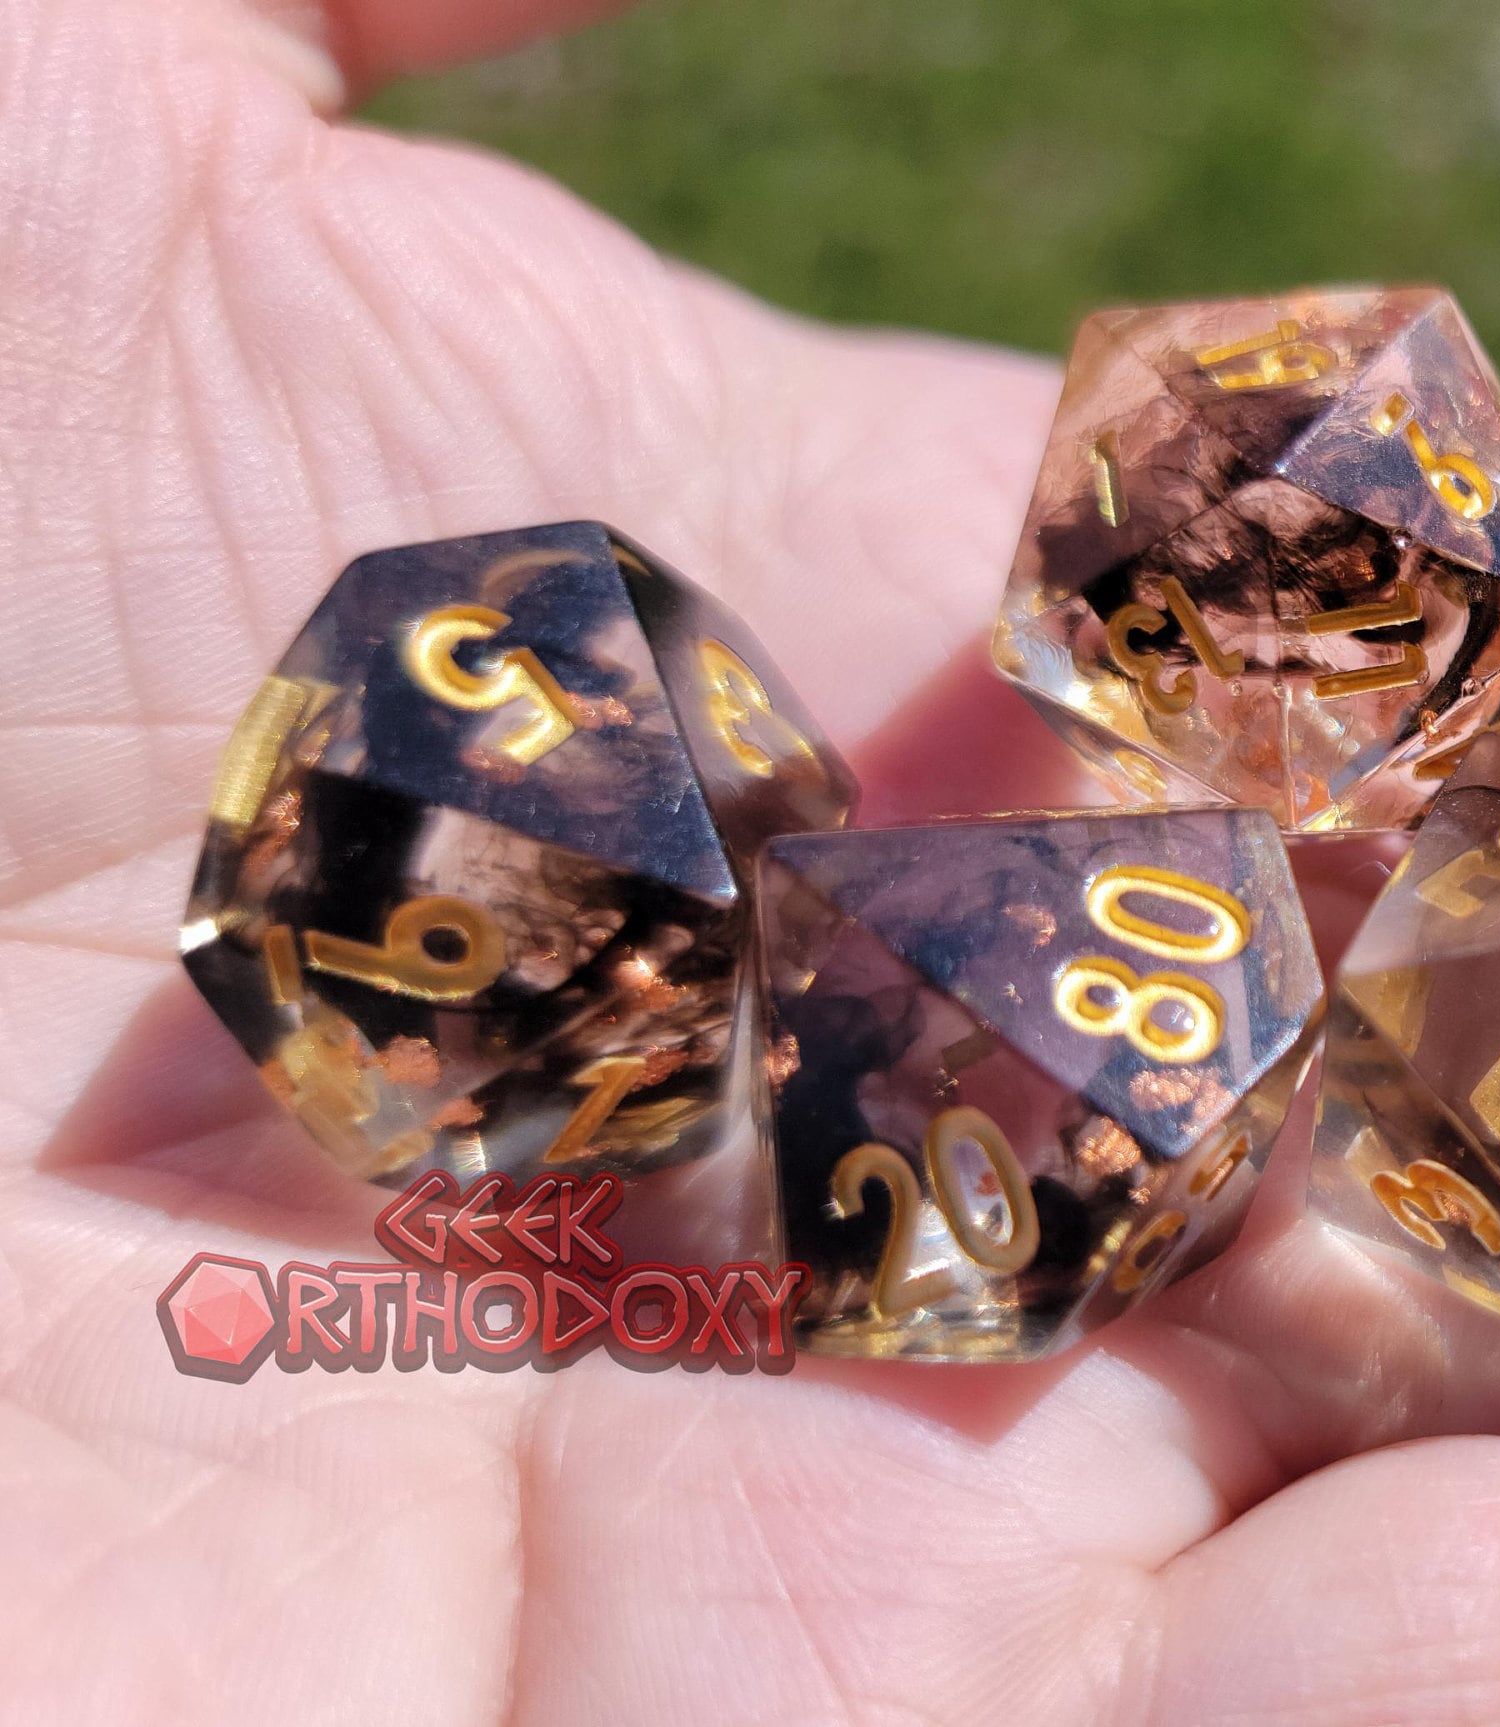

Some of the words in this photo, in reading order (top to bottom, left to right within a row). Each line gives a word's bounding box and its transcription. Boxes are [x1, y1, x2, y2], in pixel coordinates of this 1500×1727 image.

[404, 605, 575, 766] 5
[1056, 864, 1253, 1064] 80
[828, 1105, 1041, 1318] 20
